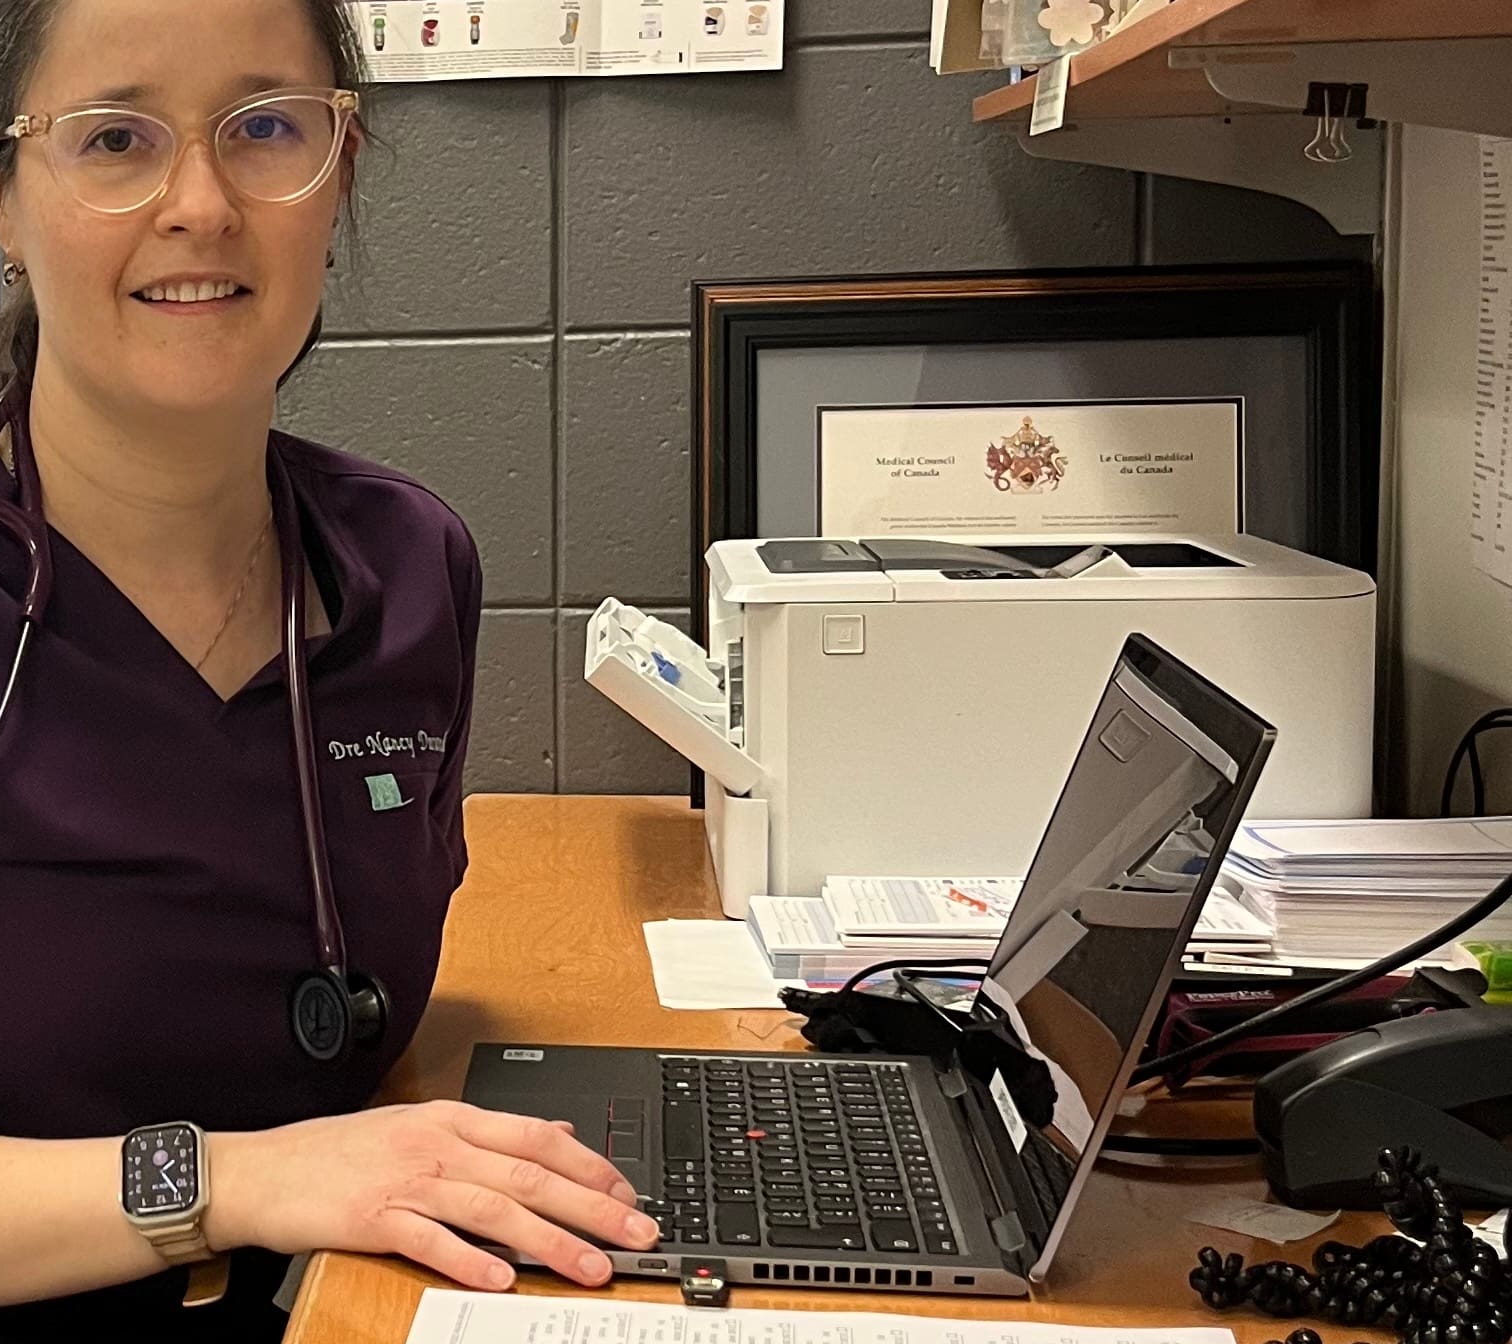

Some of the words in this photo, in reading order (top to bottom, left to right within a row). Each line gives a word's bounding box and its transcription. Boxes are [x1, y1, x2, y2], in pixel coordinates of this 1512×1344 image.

[876, 457, 914, 465] Medical
[917, 456, 955, 465] Council
[1099, 454, 1111, 462] Le
[1114, 453, 1151, 462] Conseil
[1155, 452, 1193, 462] médical
[890, 468, 901, 477] of
[904, 468, 940, 477] Canada
[1120, 466, 1133, 474] du
[1136, 465, 1173, 474] Canada
[329, 741, 364, 760] Dre
[366, 731, 415, 758] Nancy
